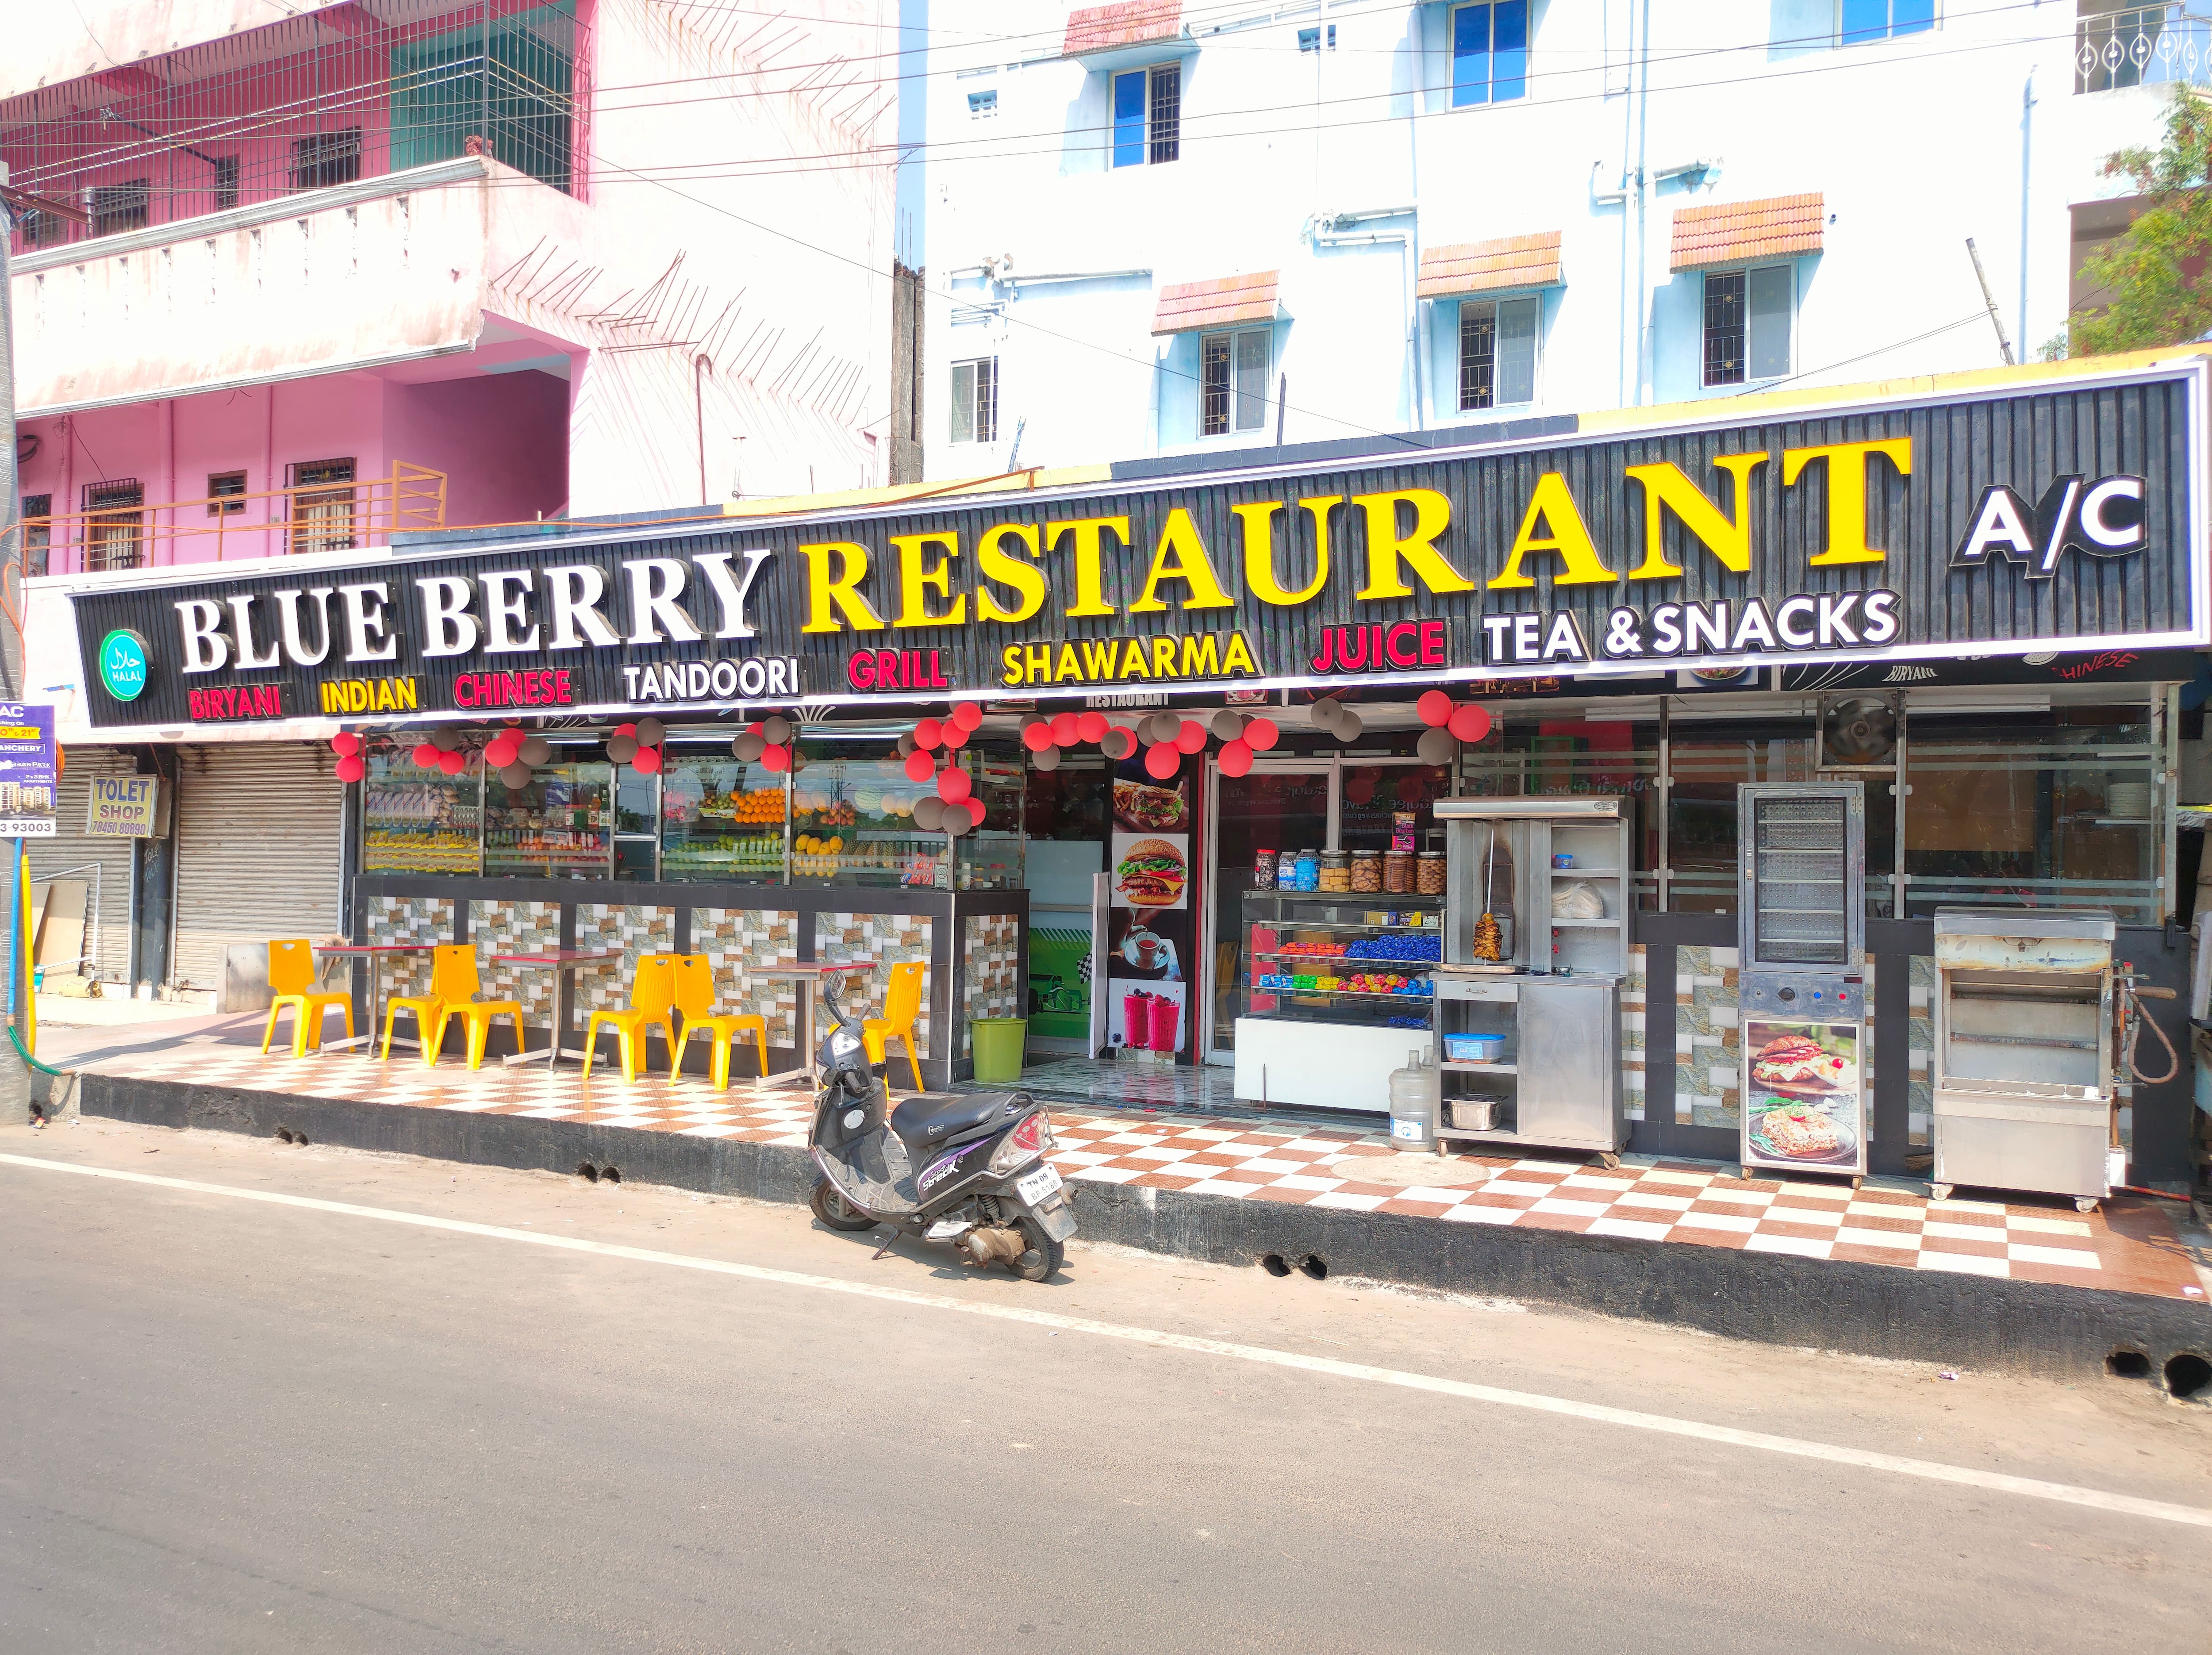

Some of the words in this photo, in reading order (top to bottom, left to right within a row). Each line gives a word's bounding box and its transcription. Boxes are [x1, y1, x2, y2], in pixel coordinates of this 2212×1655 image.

[1964, 480, 2143, 571] A/C
[174, 582, 397, 673] BLUE
[416, 549, 771, 658] BERRY
[799, 436, 1912, 633] RESTAURANT
[1313, 622, 1444, 672] JUICE
[1483, 614, 1582, 660] TEA
[111, 647, 141, 669] حلال
[849, 650, 947, 688] GRILL
[1003, 634, 1255, 685] SHAWARMA
[112, 670, 142, 682] HALAL
[624, 657, 798, 701] TANDOORI
[1882, 665, 1938, 682] BIRYANI
[189, 685, 282, 720] BIRYANI
[321, 677, 418, 713] INDIAN
[454, 670, 572, 707] CHINESE
[1086, 693, 1169, 708] RESTAURANT
[96, 779, 150, 802] TOLET
[100, 804, 145, 820] SHOP
[12, 823, 51, 832] 93003
[92, 821, 118, 833] 78450
[119, 822, 146, 836] 80890
[1026, 1179, 1039, 1188] TN
[1039, 1173, 1048, 1182] 09
[1031, 1190, 1040, 1200] BP
[1041, 1180, 1058, 1194] 5188
